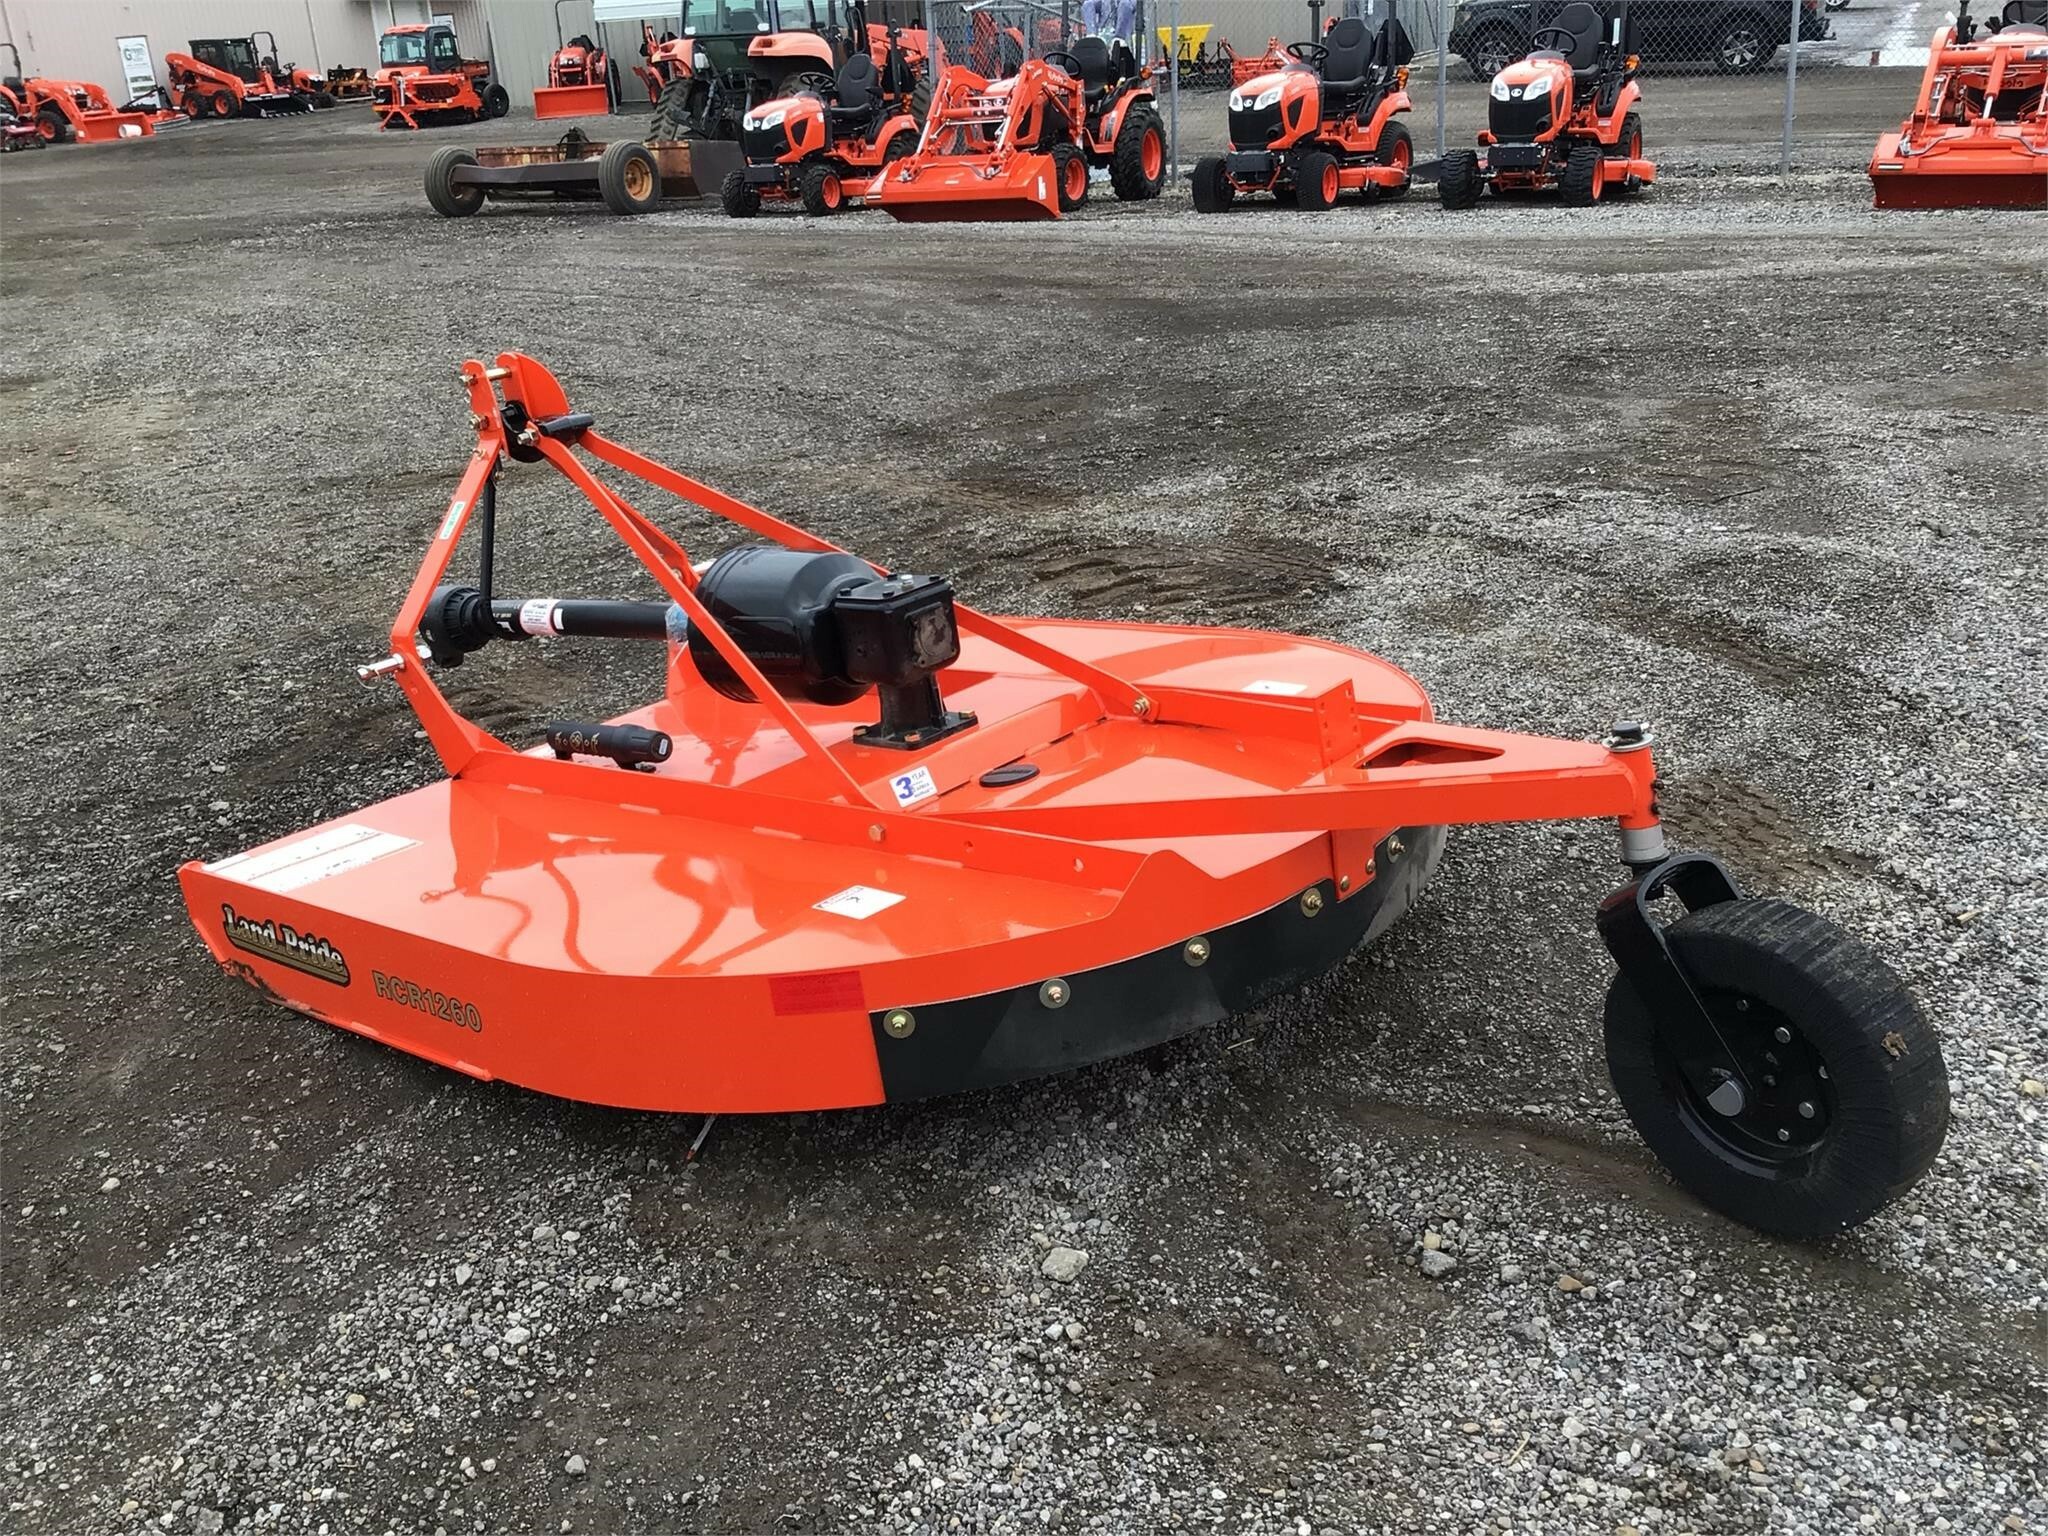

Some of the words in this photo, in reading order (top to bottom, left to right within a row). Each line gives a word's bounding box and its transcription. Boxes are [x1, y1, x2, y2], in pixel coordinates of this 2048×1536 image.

[896, 776, 914, 799] 3
[222, 903, 277, 950] Land
[279, 923, 346, 974] Pride
[372, 969, 482, 1033] RCR1260
